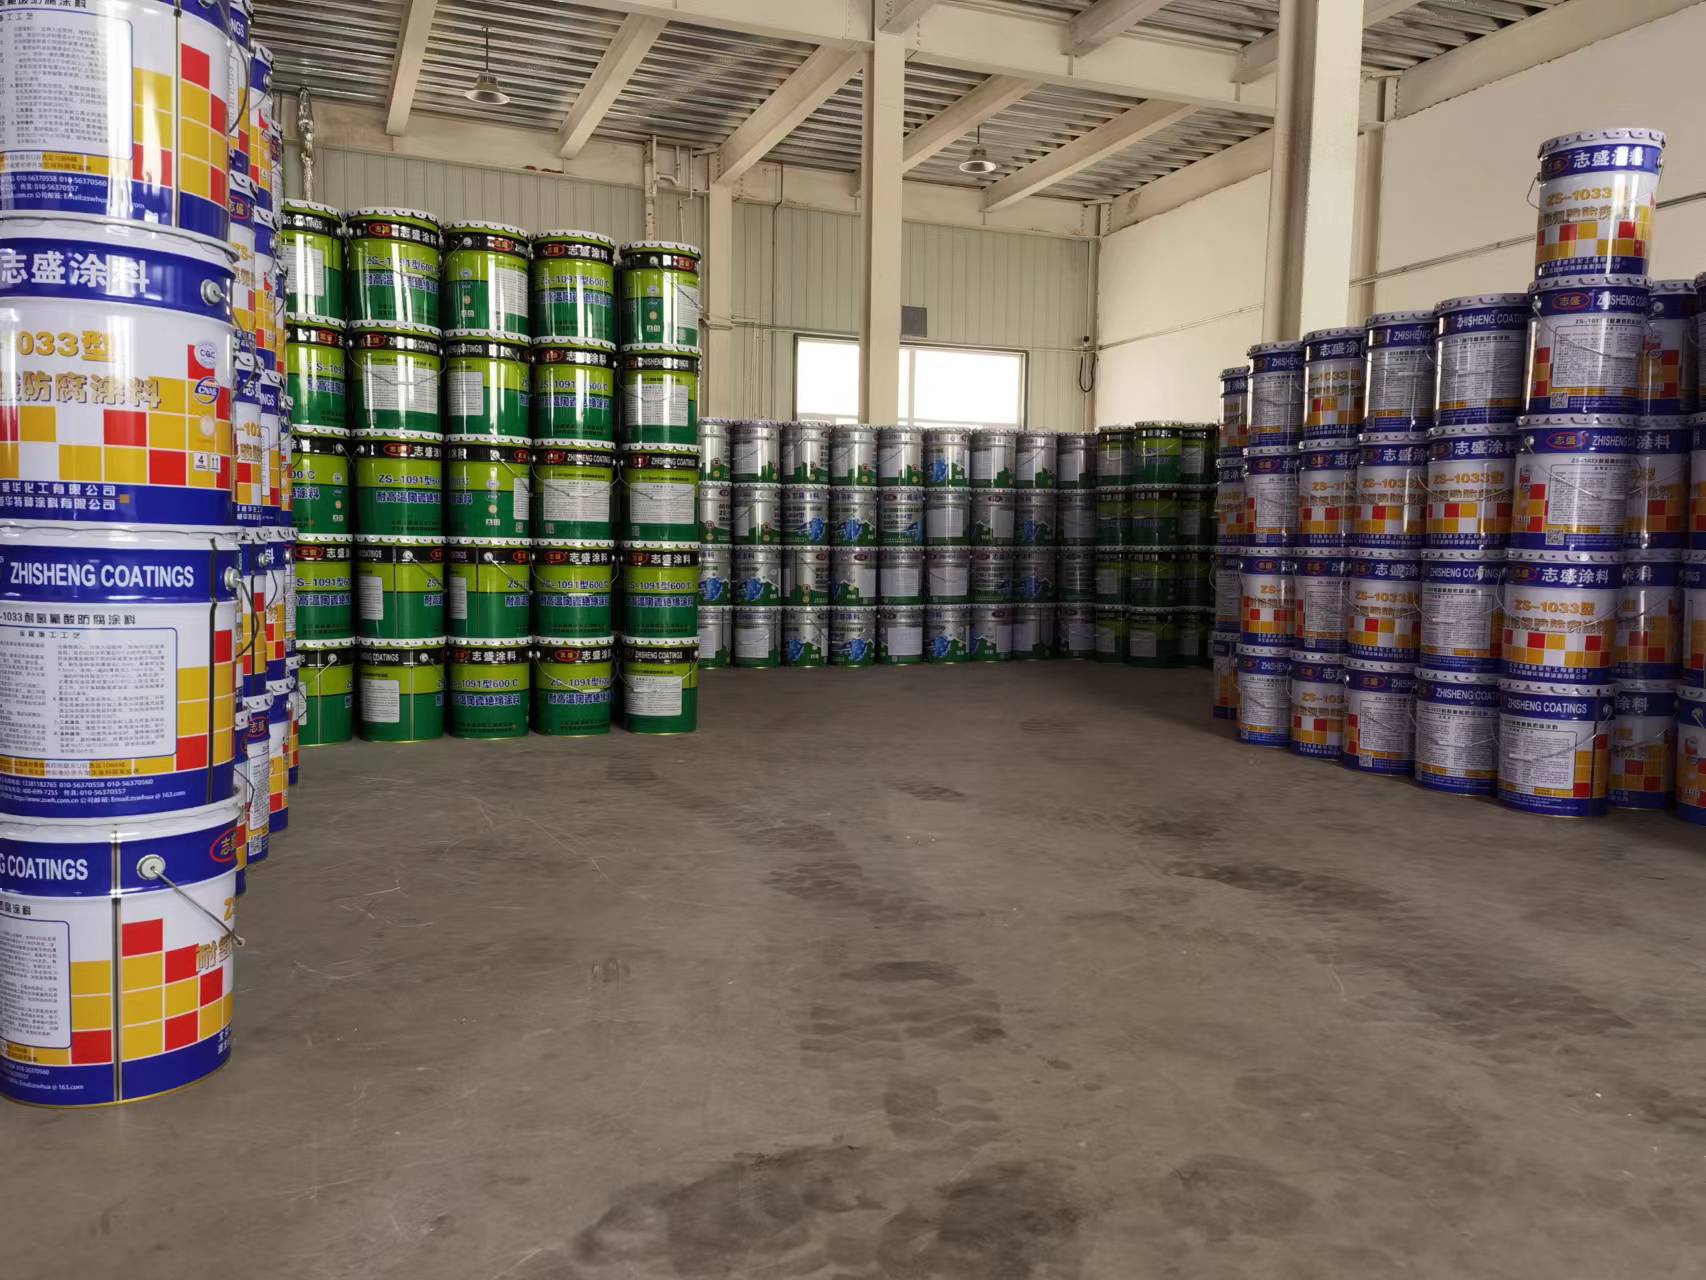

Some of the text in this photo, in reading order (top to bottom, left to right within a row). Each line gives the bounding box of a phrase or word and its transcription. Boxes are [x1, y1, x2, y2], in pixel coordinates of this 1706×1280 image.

[0, 249, 150, 293] 志盛涂料
[10, 561, 194, 588] ZHISHENG COATINGS
[1541, 567, 1609, 585] 志盛涂料
[1436, 687, 1473, 700] ZHISHENG
[1508, 698, 1588, 714] ZHISHENG COATINGS
[7, 858, 89, 881] COATINGS
